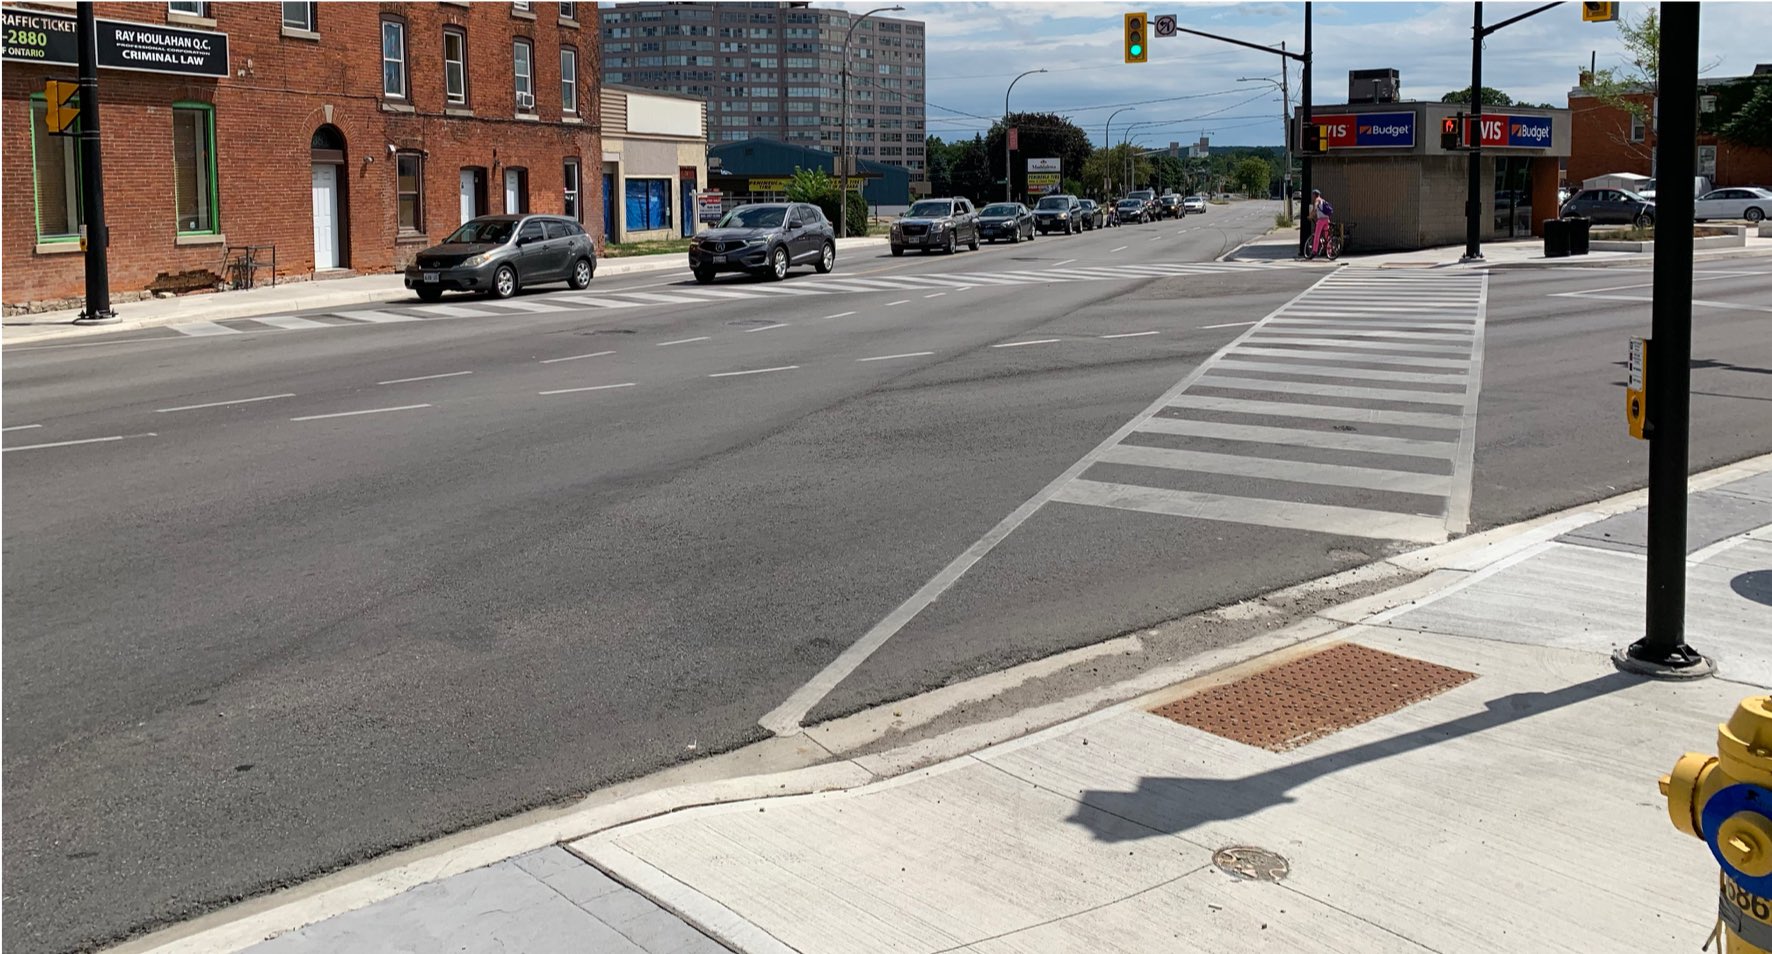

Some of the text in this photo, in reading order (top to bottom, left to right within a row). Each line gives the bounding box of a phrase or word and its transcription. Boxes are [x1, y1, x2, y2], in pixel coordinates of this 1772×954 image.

[40, 18, 78, 33] TICKET
[115, 29, 211, 50] RAY HOULAHAN Q.C.
[8, 46, 45, 58] ONTARIO
[116, 42, 211, 56] PROFESSIONAL CORPORATION
[122, 49, 204, 66] CRIMINAL LAW
[1372, 124, 1409, 137] Budget
[1480, 120, 1502, 140] VIS
[1522, 124, 1550, 142] Budget
